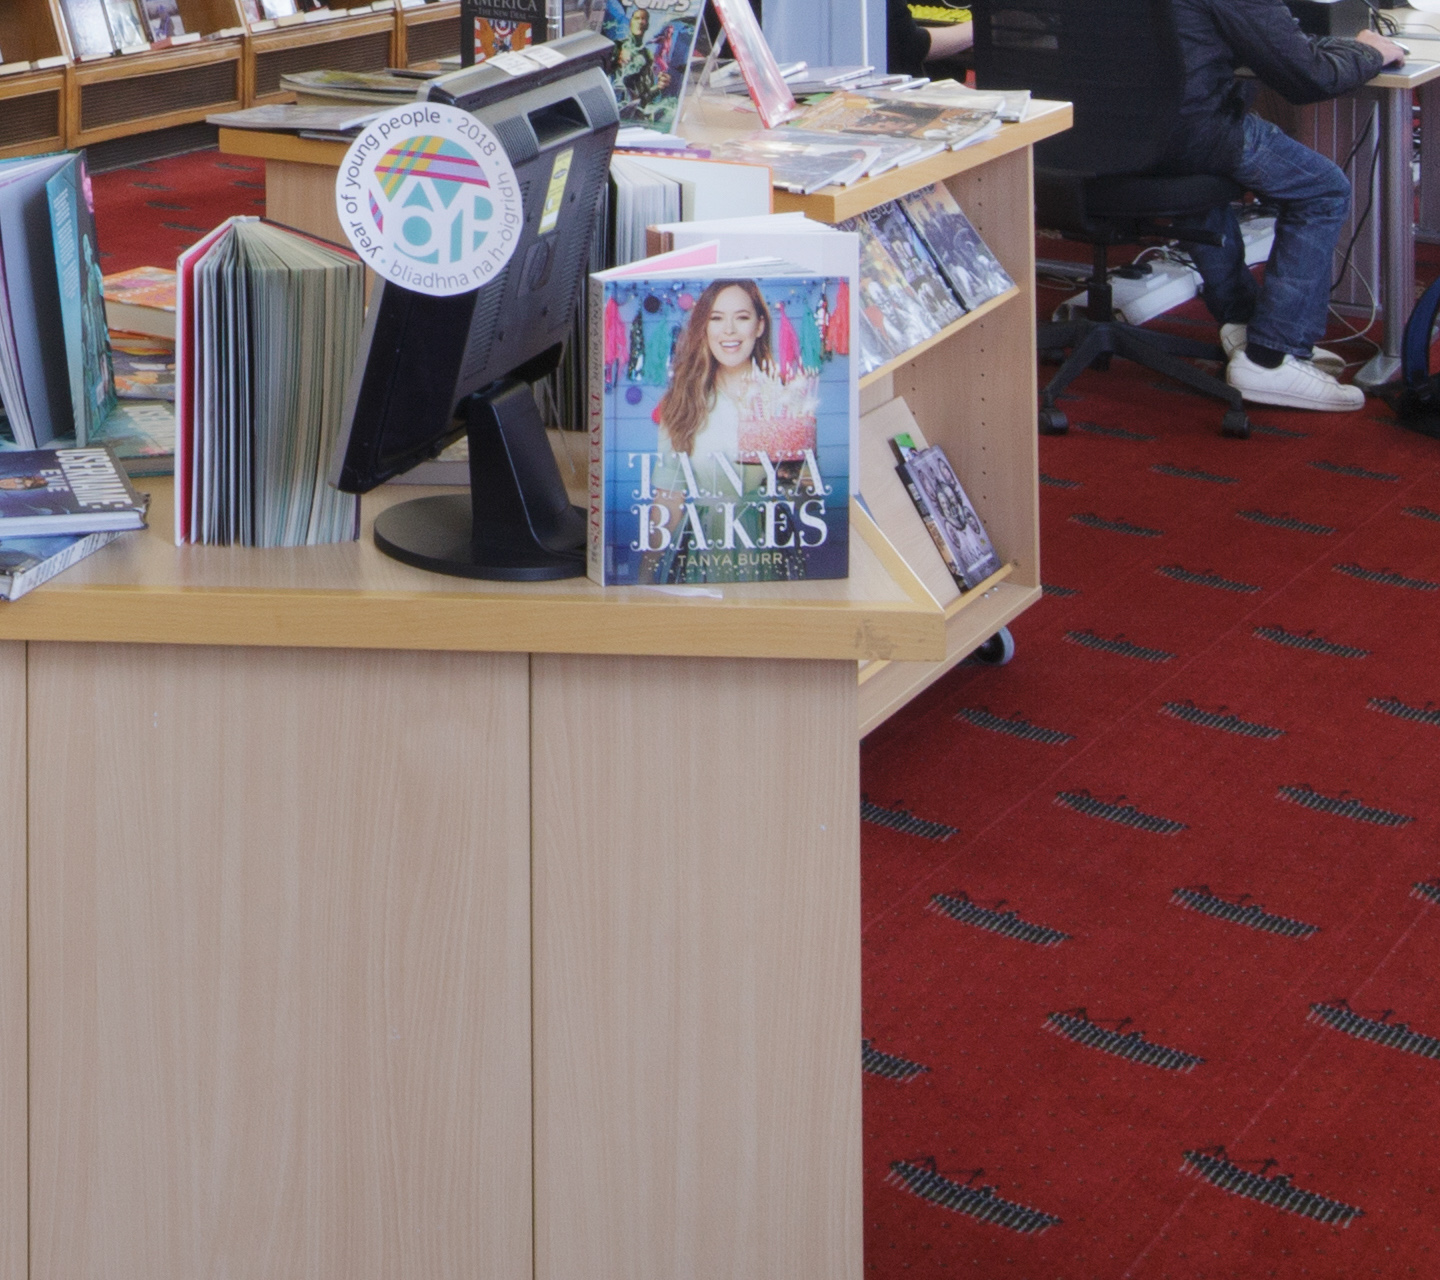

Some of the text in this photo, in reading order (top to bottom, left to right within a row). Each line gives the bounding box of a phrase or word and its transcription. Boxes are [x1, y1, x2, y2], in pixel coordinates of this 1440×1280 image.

[478, 7, 527, 19] THE NEW DEAL
[457, 117, 497, 157] 2018
[341, 107, 441, 259] year of young people
[389, 262, 469, 289] bliadhna
[472, 260, 493, 280] na
[40, 468, 70, 493] EVIE
[56, 448, 132, 510] USERNAME:
[627, 449, 833, 500] TANYA
[630, 499, 828, 552] BAKES
[678, 553, 783, 567] TANYA BURR
